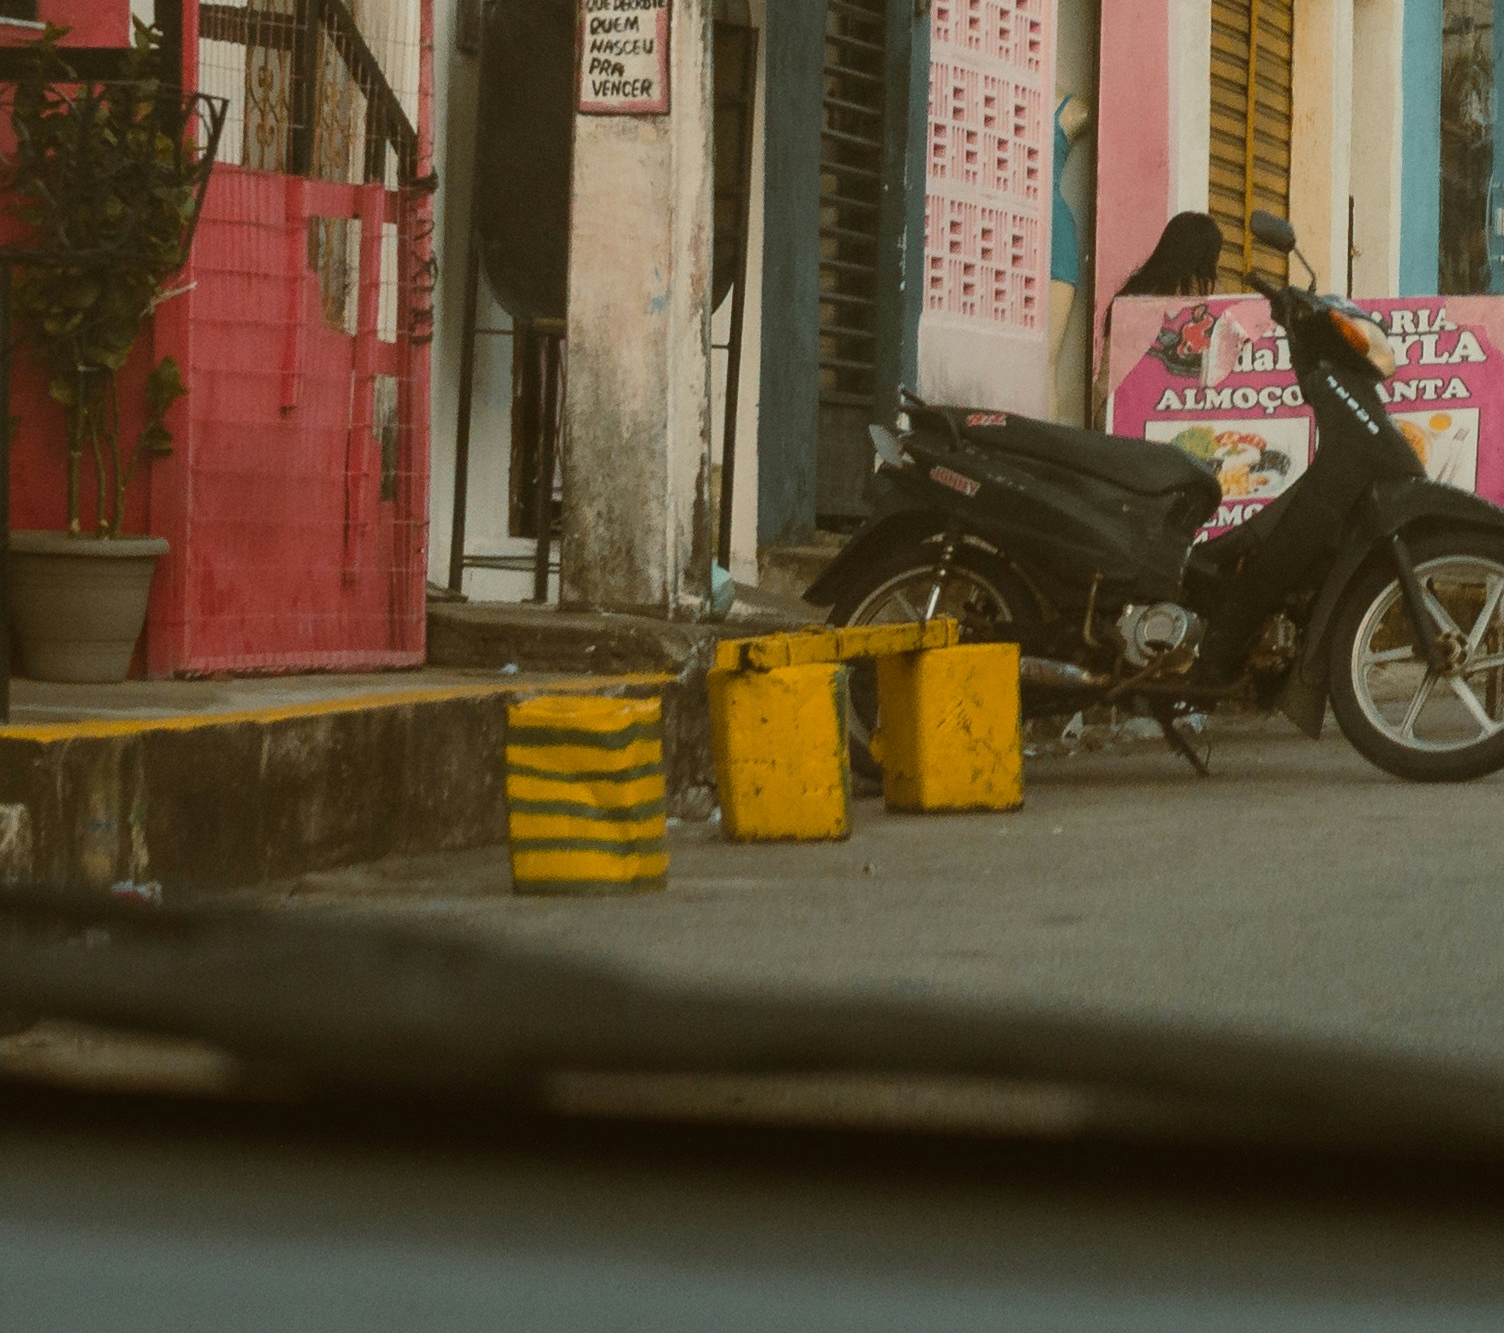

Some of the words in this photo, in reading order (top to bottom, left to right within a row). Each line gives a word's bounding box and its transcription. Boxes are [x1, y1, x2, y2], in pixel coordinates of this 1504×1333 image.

[590, 15, 640, 35] QUEM
[590, 38, 655, 56] NASCEU
[588, 57, 625, 77] PRA
[592, 78, 653, 98] VENCER
[1156, 380, 1305, 415] ALMOÇO
